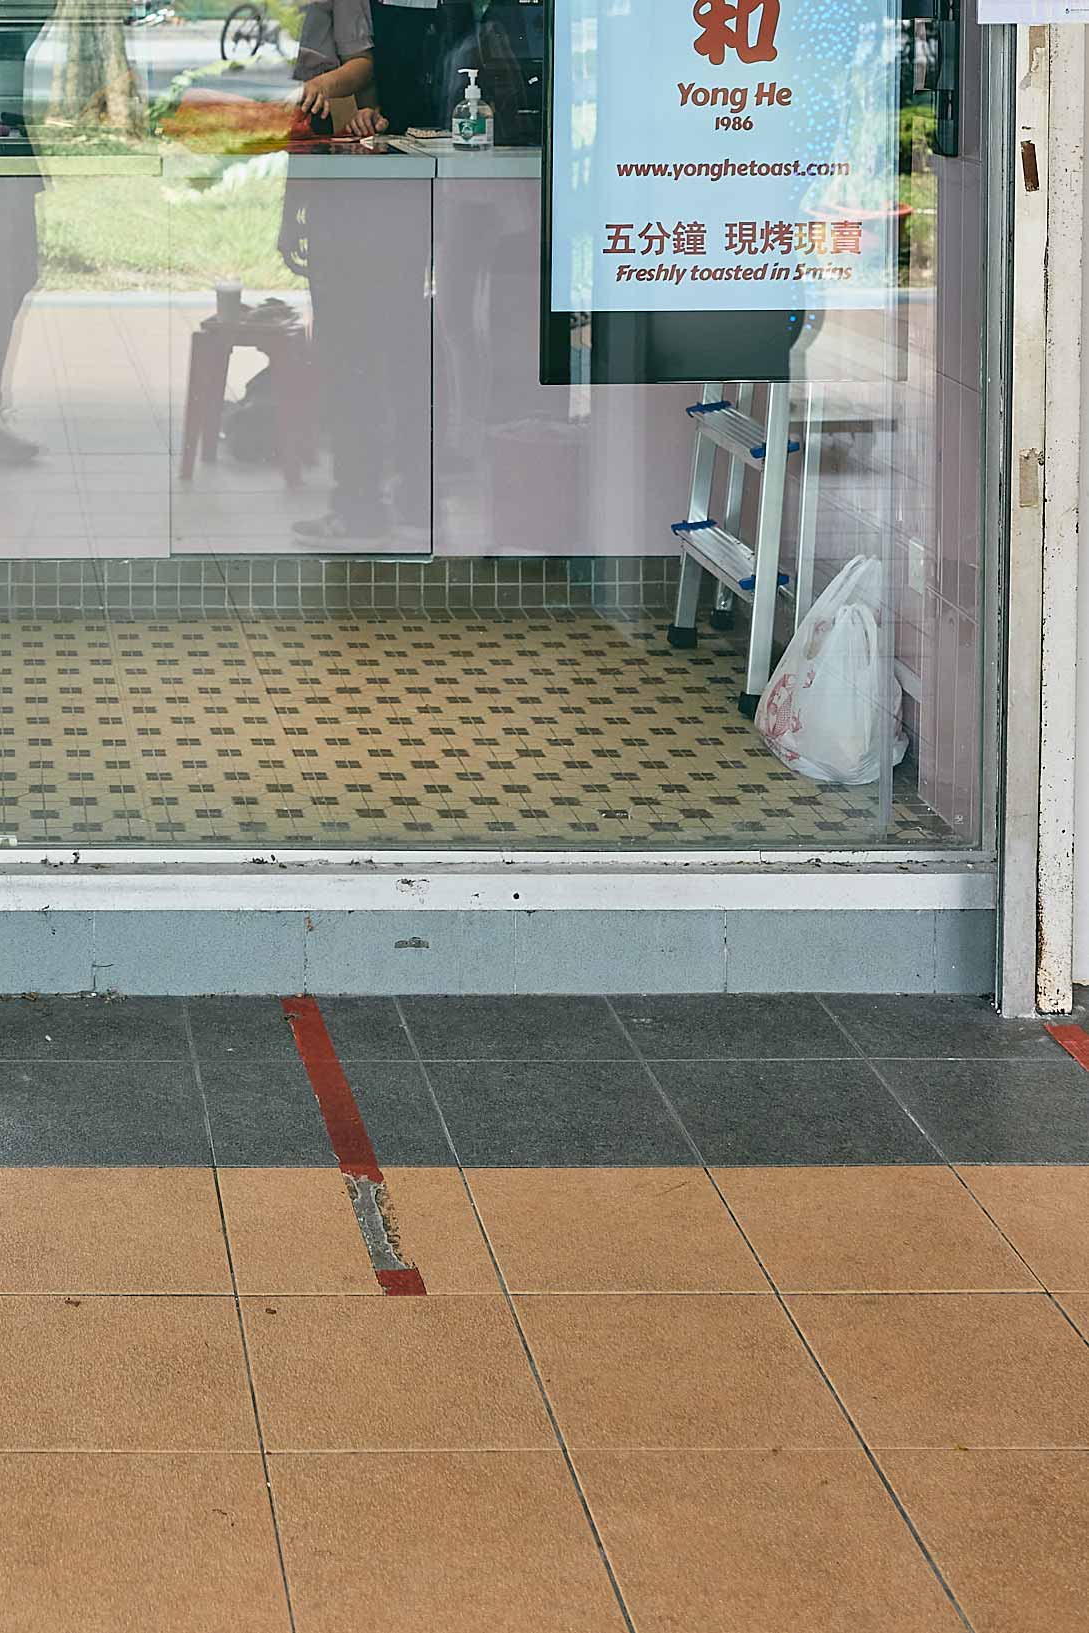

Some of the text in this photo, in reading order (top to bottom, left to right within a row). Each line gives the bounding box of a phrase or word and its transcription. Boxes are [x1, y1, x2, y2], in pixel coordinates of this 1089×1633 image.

[677, 82, 792, 113] Yong He
[715, 116, 754, 131] 1986
[617, 159, 851, 181] www.yonghetoast.com
[602, 220, 863, 256] 五分鐘 現烤現賣
[617, 264, 687, 285] Freshly
[691, 264, 769, 281] toasted
[770, 263, 792, 280] in
